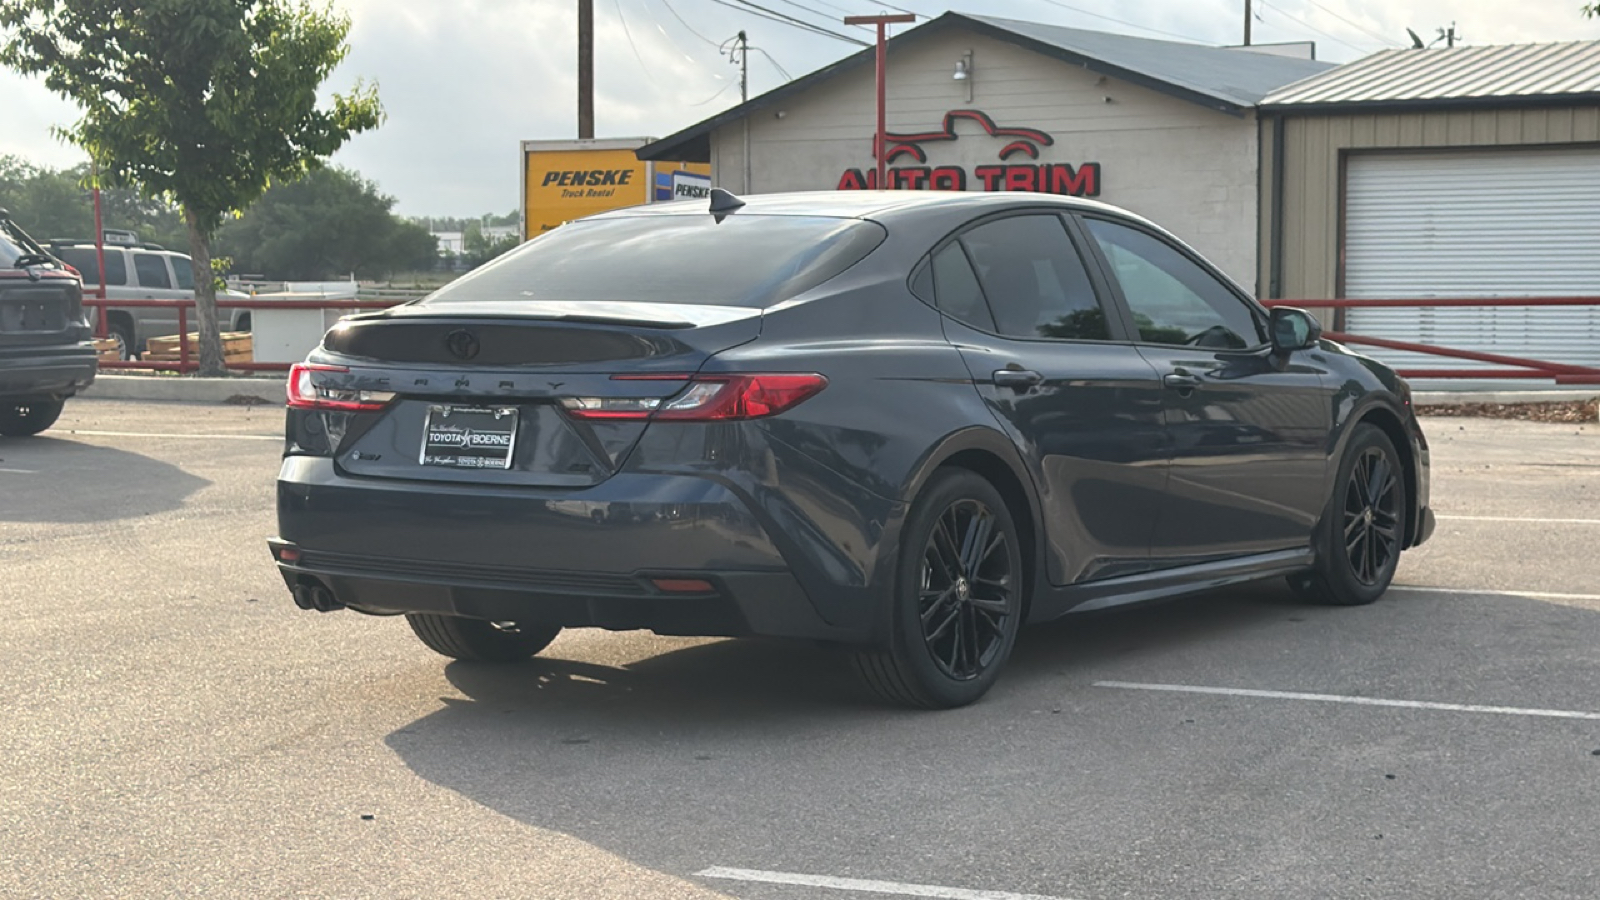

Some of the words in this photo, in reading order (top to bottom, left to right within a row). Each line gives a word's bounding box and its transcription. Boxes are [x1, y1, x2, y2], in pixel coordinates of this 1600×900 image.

[541, 169, 634, 187] PENSKE
[837, 166, 965, 191] AUTO
[975, 162, 1100, 195] TRIM
[561, 189, 585, 198] Truck
[586, 188, 615, 197] Rental
[676, 183, 710, 198] PENSKE
[429, 433, 461, 442] TOYOTA
[473, 434, 510, 445] BOERNE
